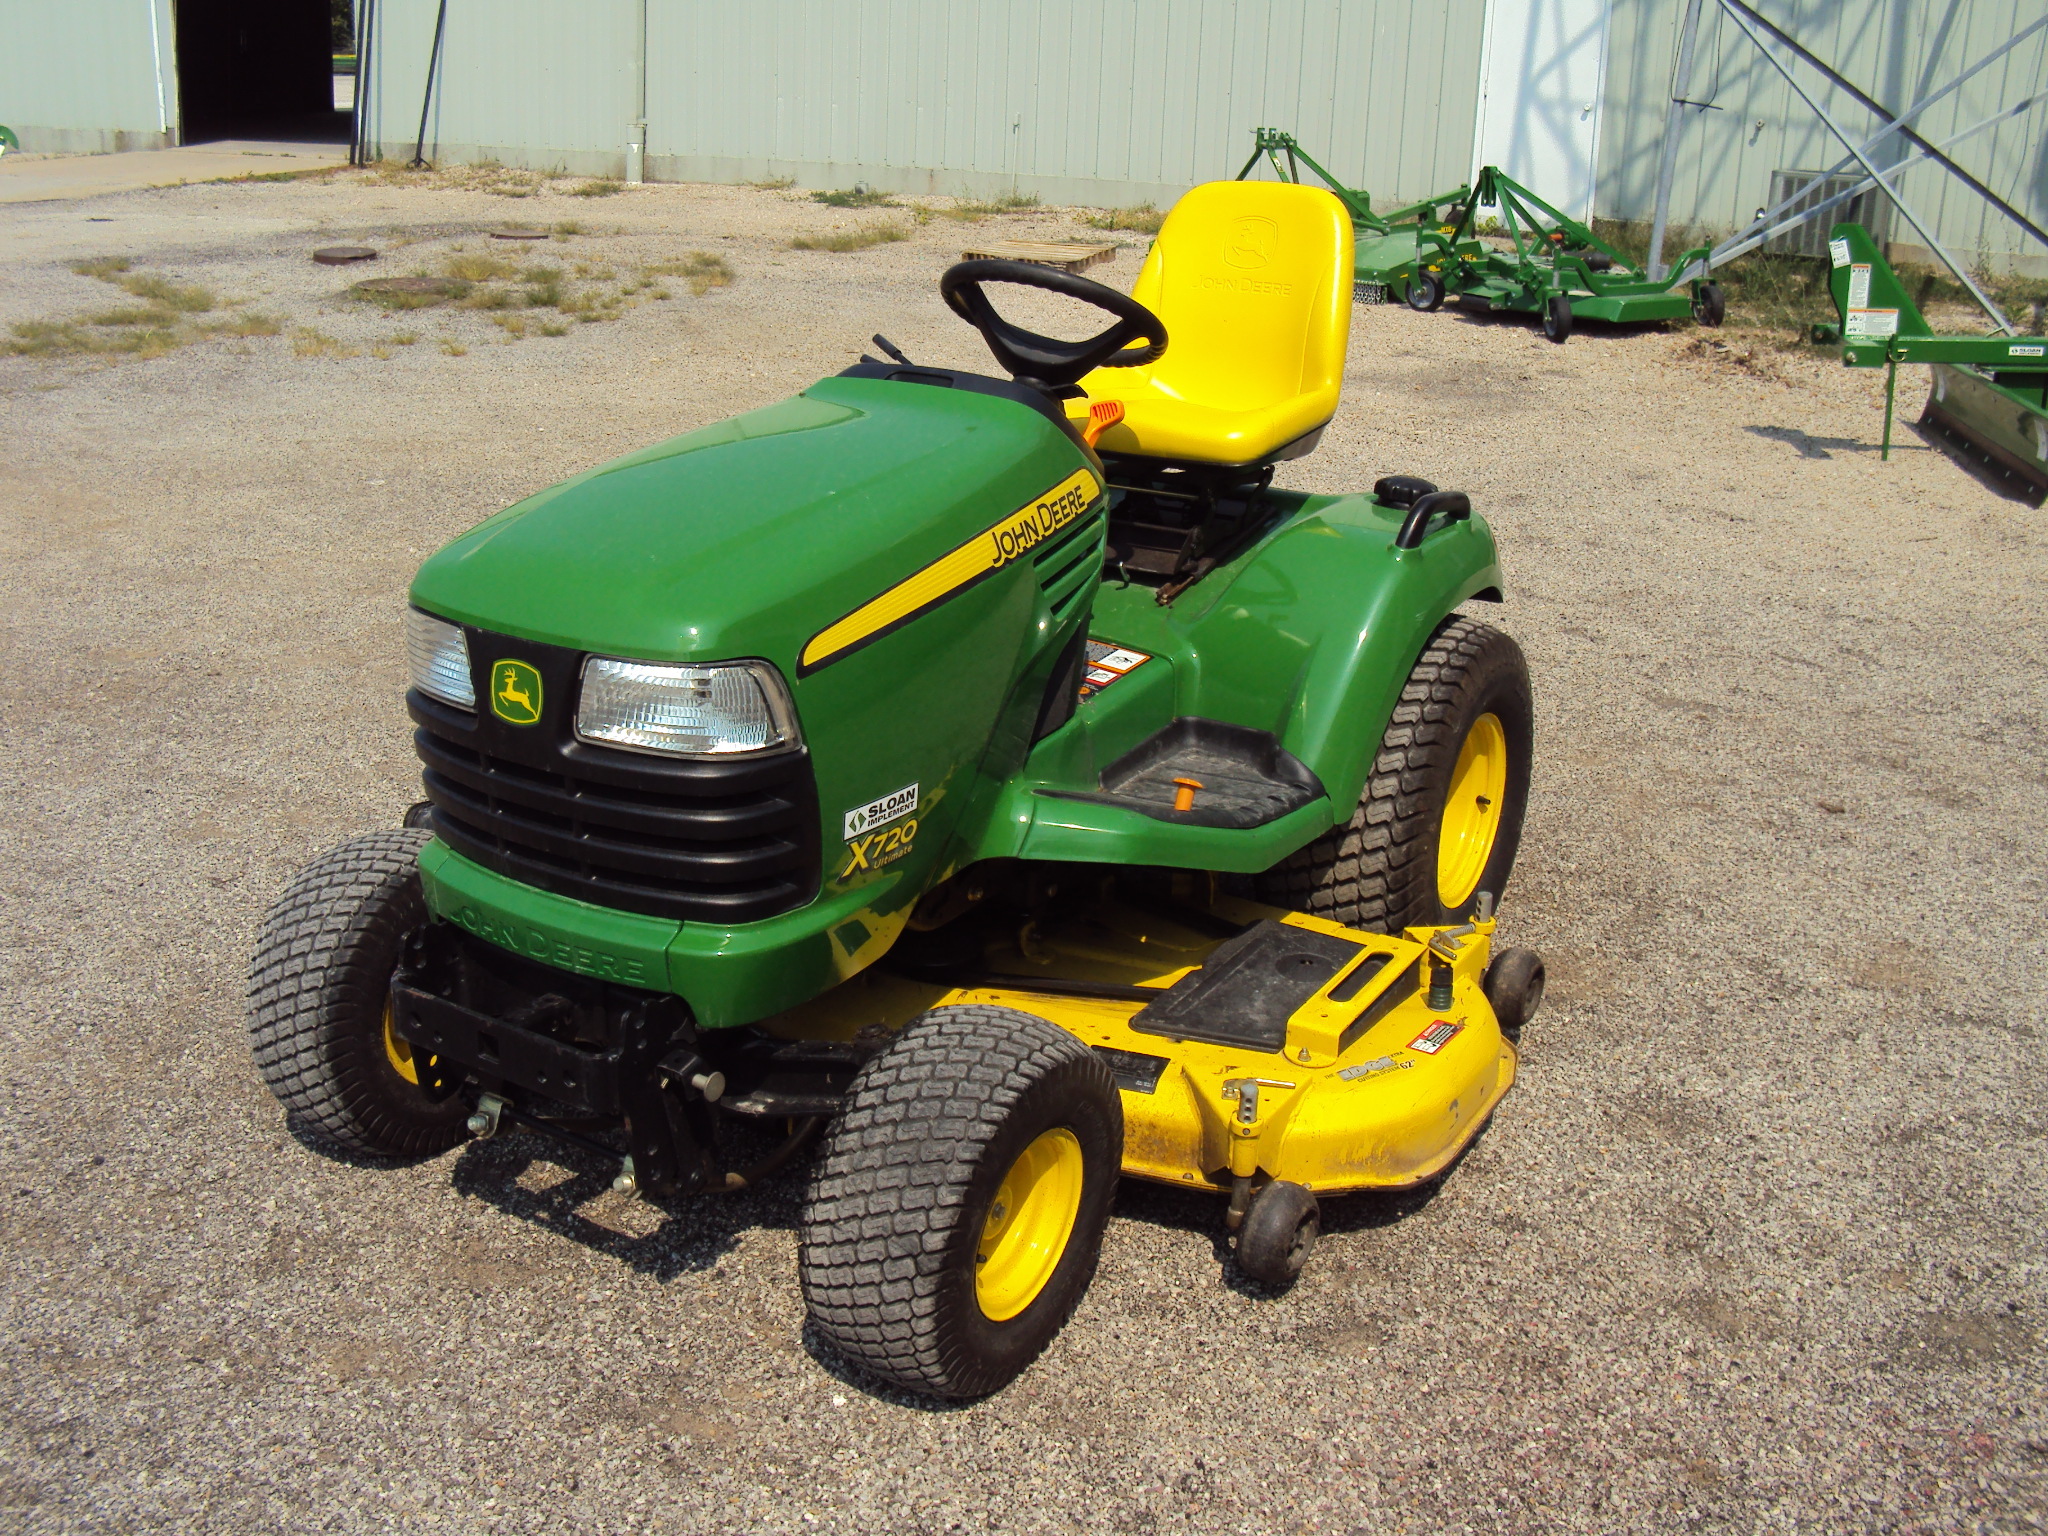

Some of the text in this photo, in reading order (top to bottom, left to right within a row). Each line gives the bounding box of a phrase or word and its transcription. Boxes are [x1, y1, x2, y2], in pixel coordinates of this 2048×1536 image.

[1191, 274, 1293, 298] JOHN DEERE
[991, 484, 1086, 565] JOHN DEERE
[867, 800, 915, 828] IMPLEMENT
[868, 787, 916, 819] SLOAN
[838, 819, 918, 882] X720
[873, 844, 913, 870] Ultimate
[525, 926, 646, 984] DEERE
[1357, 1072, 1380, 1083] CUTTING
[1379, 1065, 1400, 1075] SYSTEM
